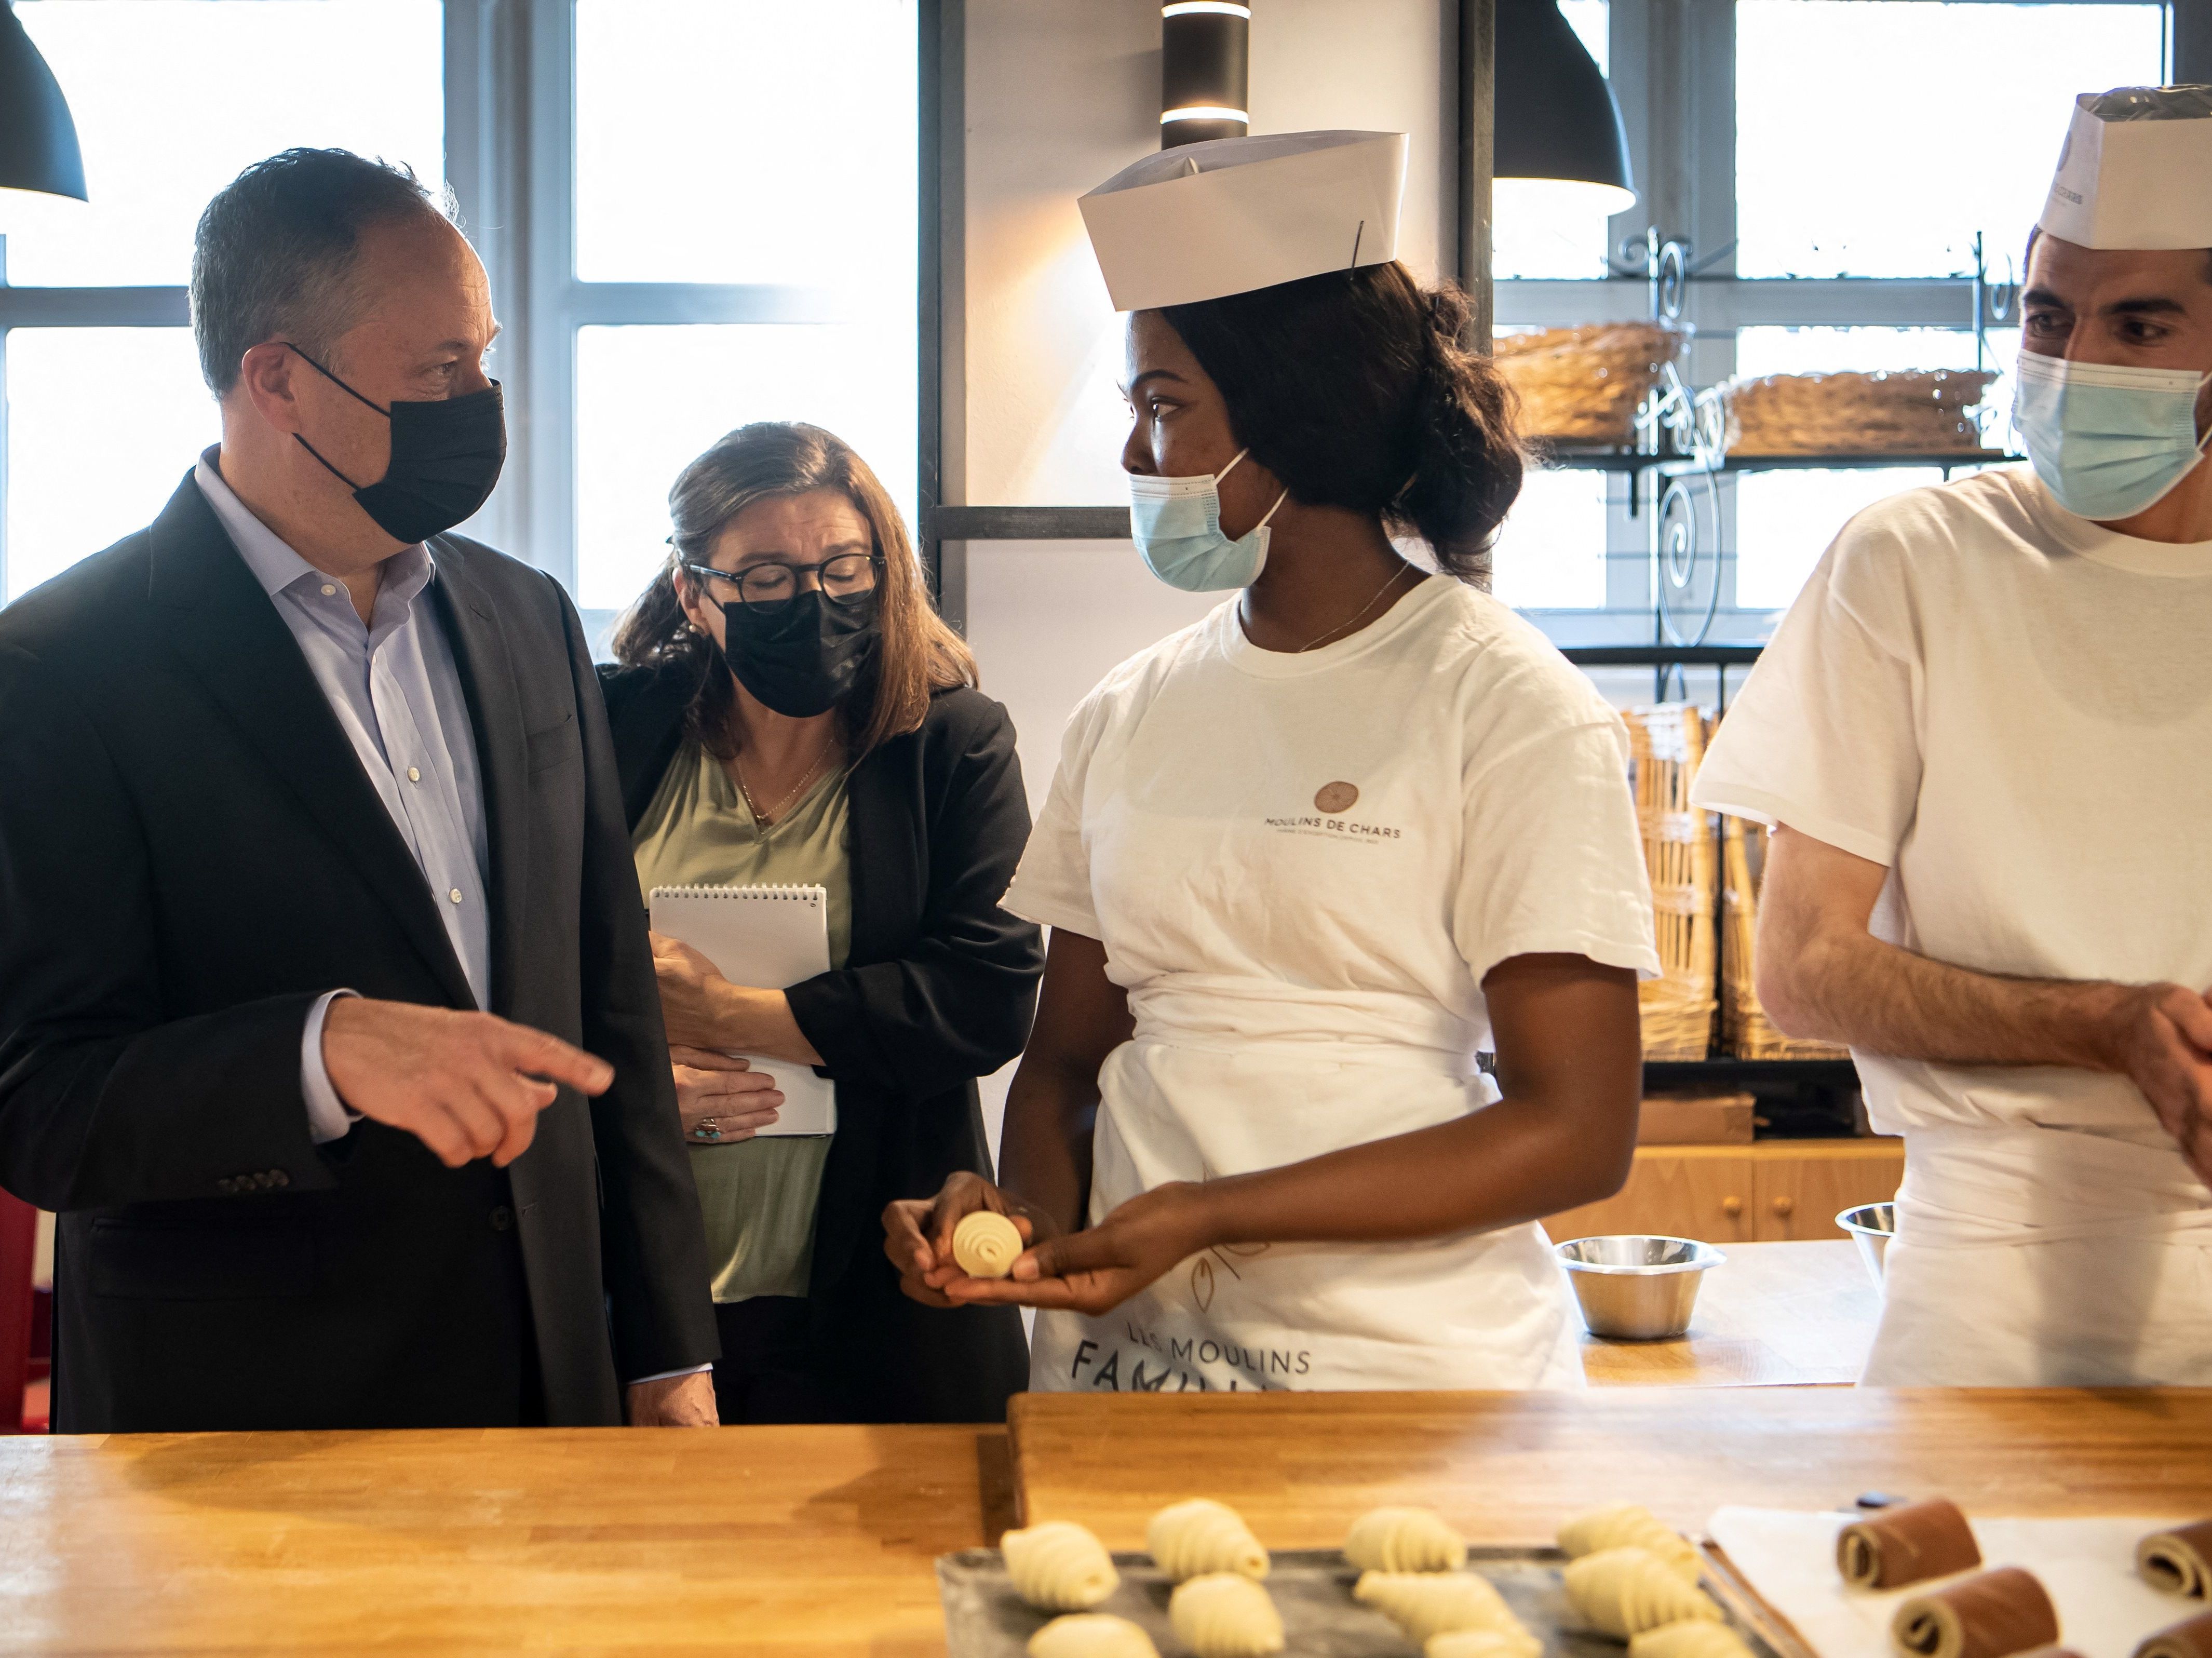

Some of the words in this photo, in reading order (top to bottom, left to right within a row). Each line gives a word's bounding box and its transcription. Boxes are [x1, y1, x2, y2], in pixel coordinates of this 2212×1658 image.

[1327, 819, 1345, 832] DE
[1349, 824, 1400, 839] CHARS
[1171, 1337, 1311, 1374] MOULINS
